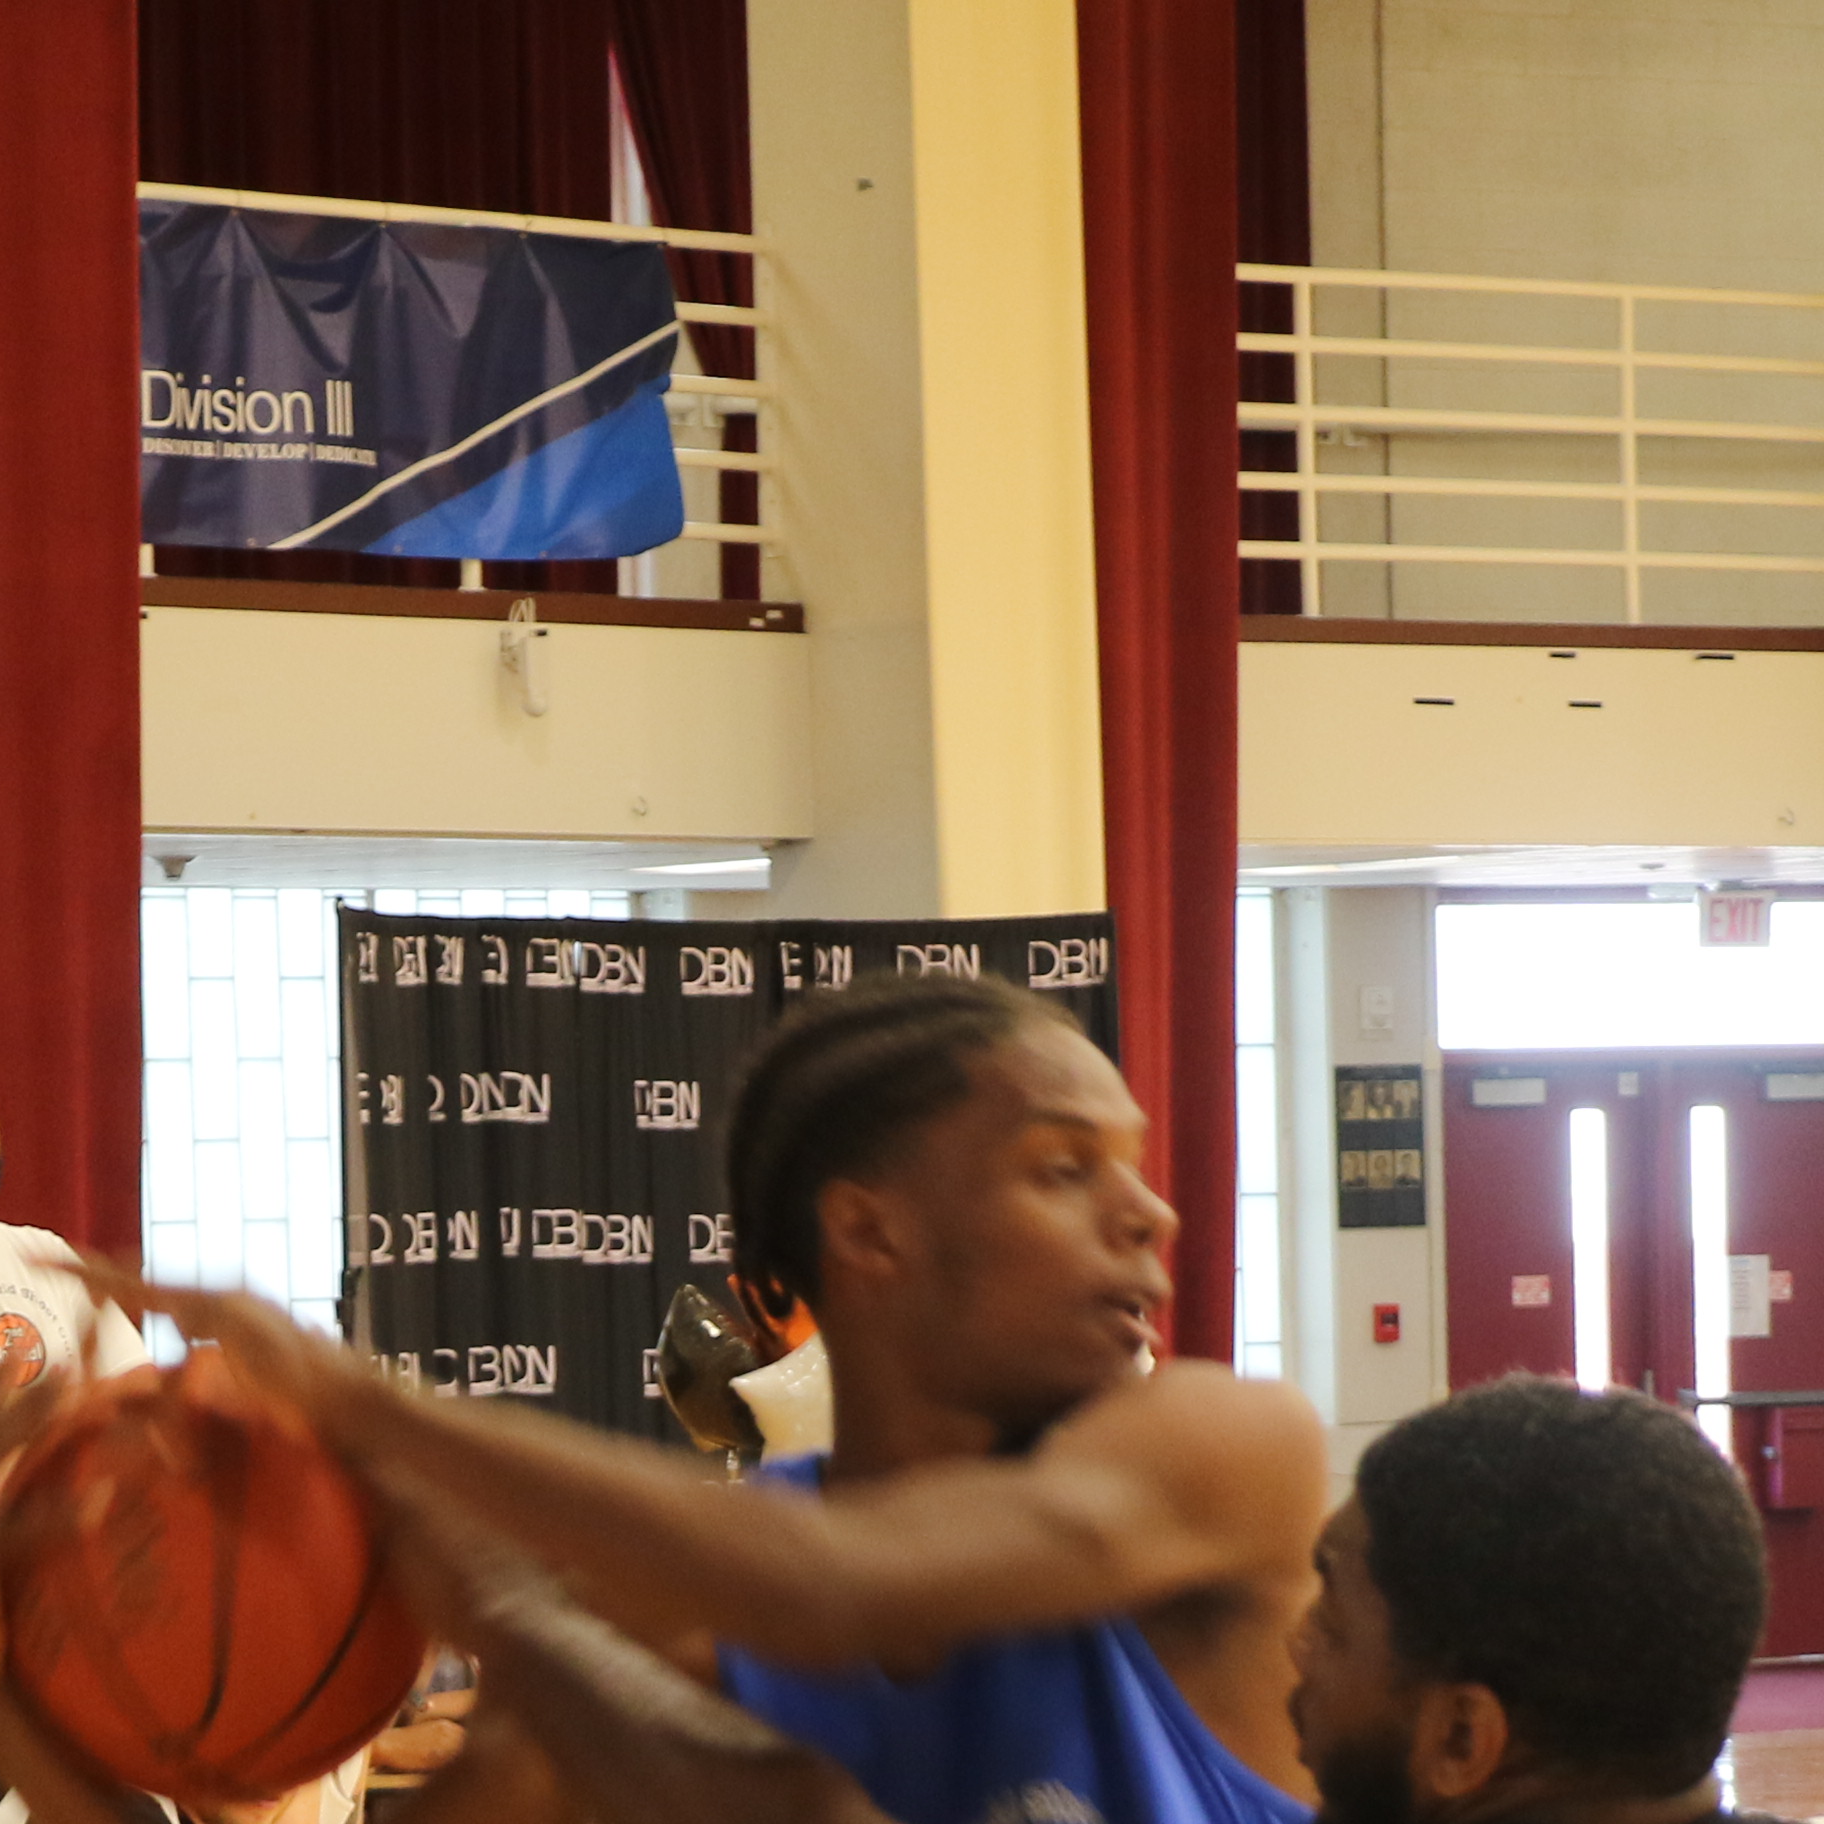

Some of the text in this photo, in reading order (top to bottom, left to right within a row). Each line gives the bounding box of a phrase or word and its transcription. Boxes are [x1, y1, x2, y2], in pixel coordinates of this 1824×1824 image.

[141, 367, 354, 438] Division III
[1708, 897, 1765, 942] EXIT
[578, 942, 646, 992] DBN
[678, 946, 754, 993] DBN
[895, 943, 980, 981] DBN
[1027, 937, 1109, 988] DBN
[582, 1213, 654, 1263] DBN
